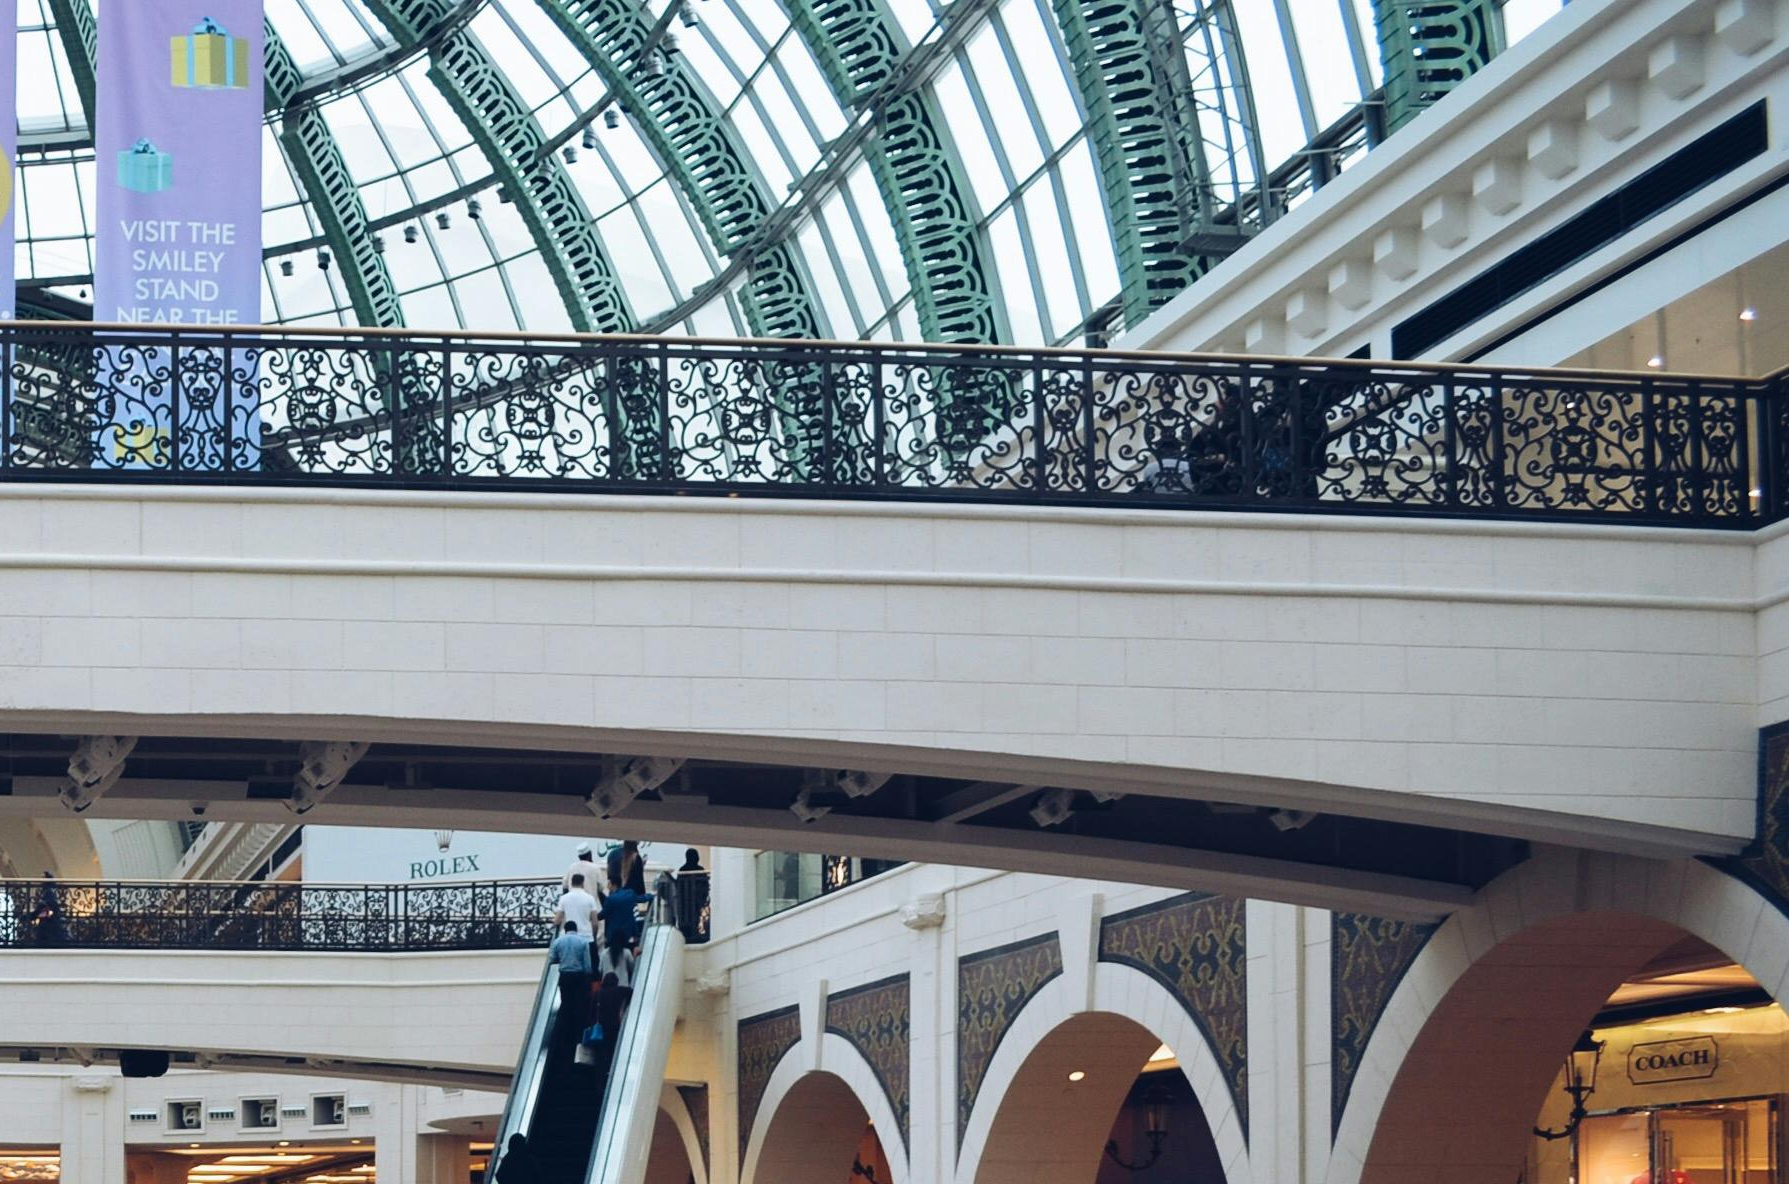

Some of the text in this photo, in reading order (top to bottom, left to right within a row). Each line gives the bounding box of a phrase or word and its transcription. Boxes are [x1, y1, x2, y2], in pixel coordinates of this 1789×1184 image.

[120, 220, 236, 245] VISIT THE
[132, 249, 225, 273] SMILEY
[135, 278, 219, 302] STAND
[116, 307, 238, 325] NEAR THE
[410, 854, 480, 879] ROLEX
[1635, 1049, 1709, 1072] COACH
